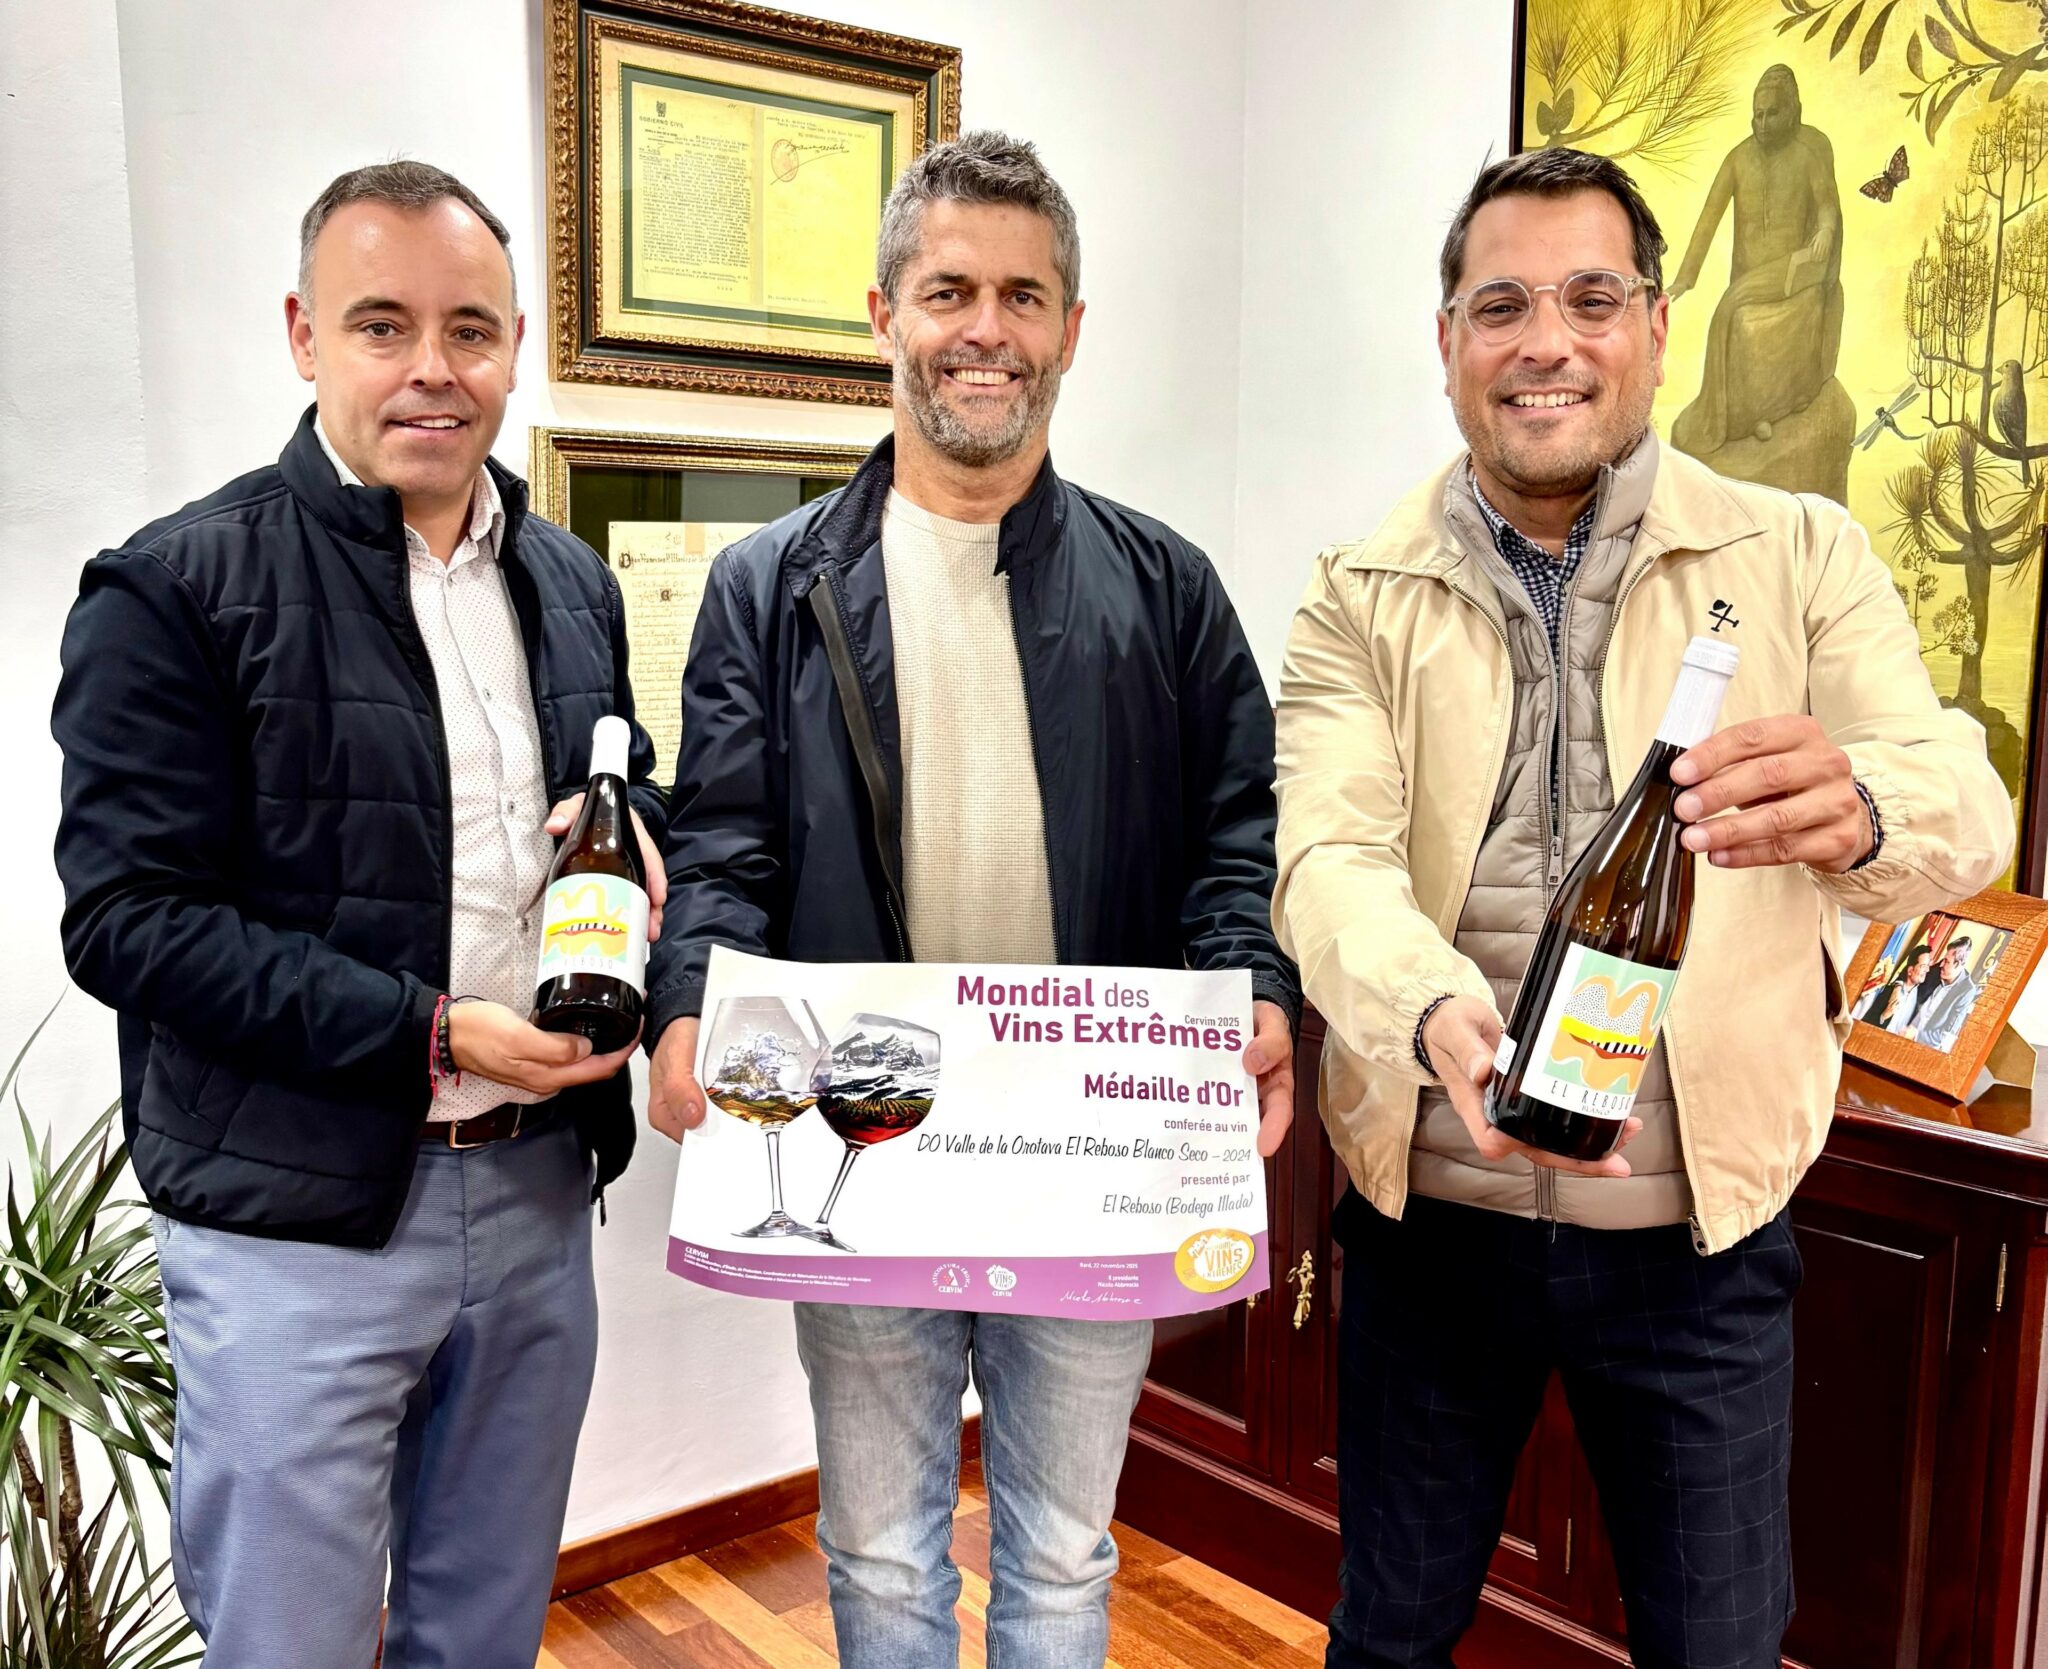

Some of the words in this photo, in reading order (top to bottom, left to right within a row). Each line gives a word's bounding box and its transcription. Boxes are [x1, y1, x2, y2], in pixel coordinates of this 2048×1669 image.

[957, 976, 1095, 1007] Mondial
[1104, 982, 1150, 1008] des
[989, 1012, 1064, 1042] Vins
[1074, 1011, 1242, 1051] Extrêmes
[1184, 1014, 1216, 1026] Cervim
[1217, 1016, 1240, 1027] 2025
[1084, 1071, 1190, 1103] Médaille
[1196, 1080, 1244, 1107] d'Or
[1551, 1080, 1568, 1098] EL
[1164, 1119, 1212, 1132] conferée
[1214, 1123, 1228, 1133] au
[1230, 1121, 1248, 1133] vin
[917, 1133, 941, 1152] DO
[945, 1134, 975, 1153] Valle
[979, 1136, 994, 1154] de
[996, 1134, 1008, 1154] la
[1011, 1135, 1062, 1155] Orotava
[1065, 1136, 1081, 1155] El
[1083, 1136, 1129, 1157] Reboso
[1132, 1138, 1175, 1160] Blanco
[1178, 1142, 1208, 1161] Seco
[1222, 1149, 1252, 1162] 2024
[1181, 1173, 1230, 1187] presenté
[1232, 1173, 1251, 1186] par
[1102, 1194, 1117, 1213] El
[1119, 1195, 1162, 1214] Reboso
[1165, 1197, 1214, 1218] (Bodega
[1204, 1247, 1243, 1272] VINS
[994, 1273, 1014, 1285] VINS
